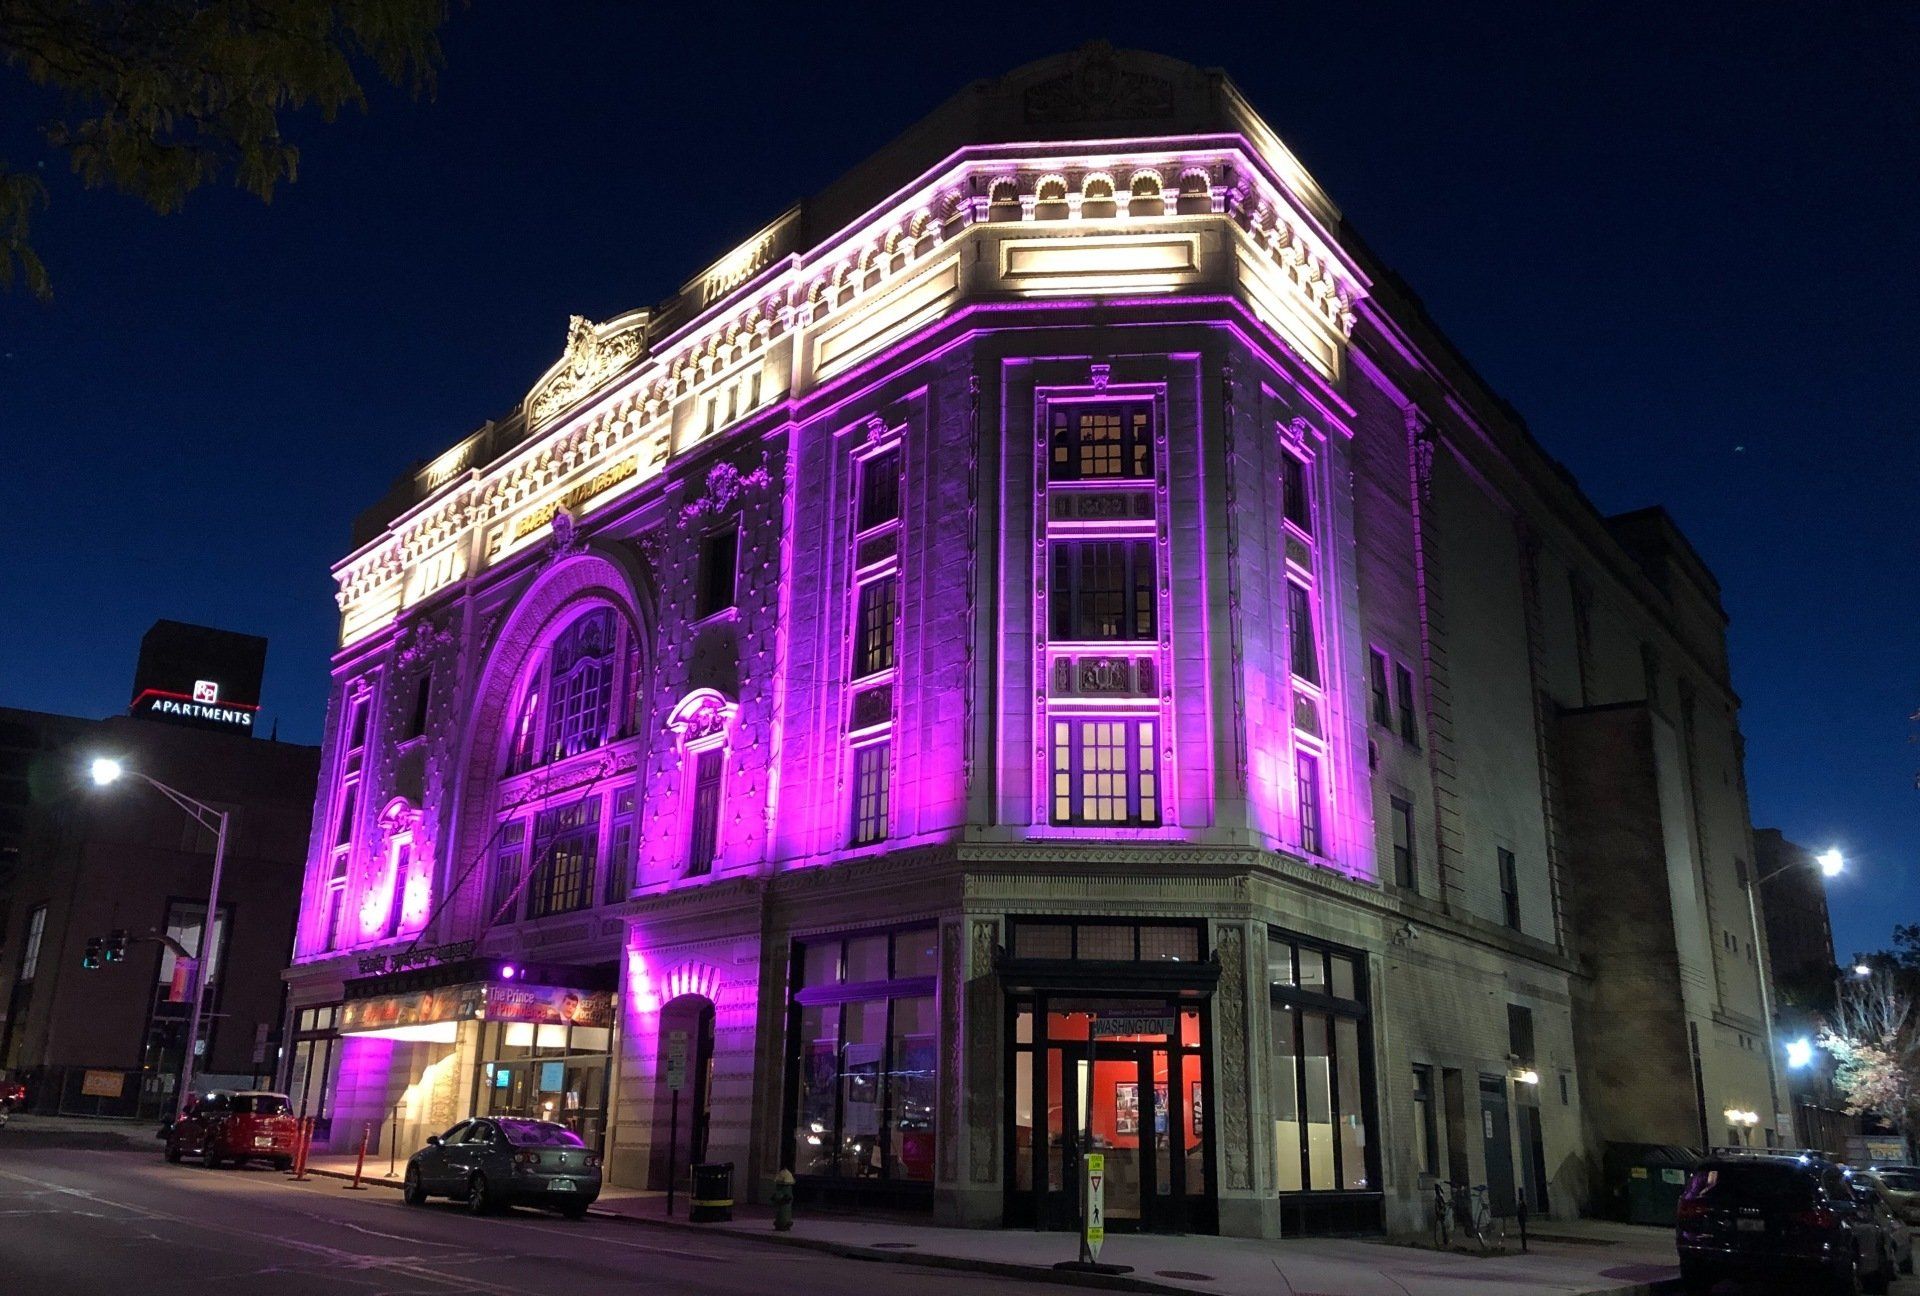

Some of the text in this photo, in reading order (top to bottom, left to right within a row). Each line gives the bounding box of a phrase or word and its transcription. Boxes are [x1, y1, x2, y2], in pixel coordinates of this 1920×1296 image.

[151, 700, 252, 725] APARTMENTS
[490, 987, 535, 1004] The Prince
[500, 1003, 546, 1018] Providence
[1097, 1019, 1164, 1034] WASHINGTON
